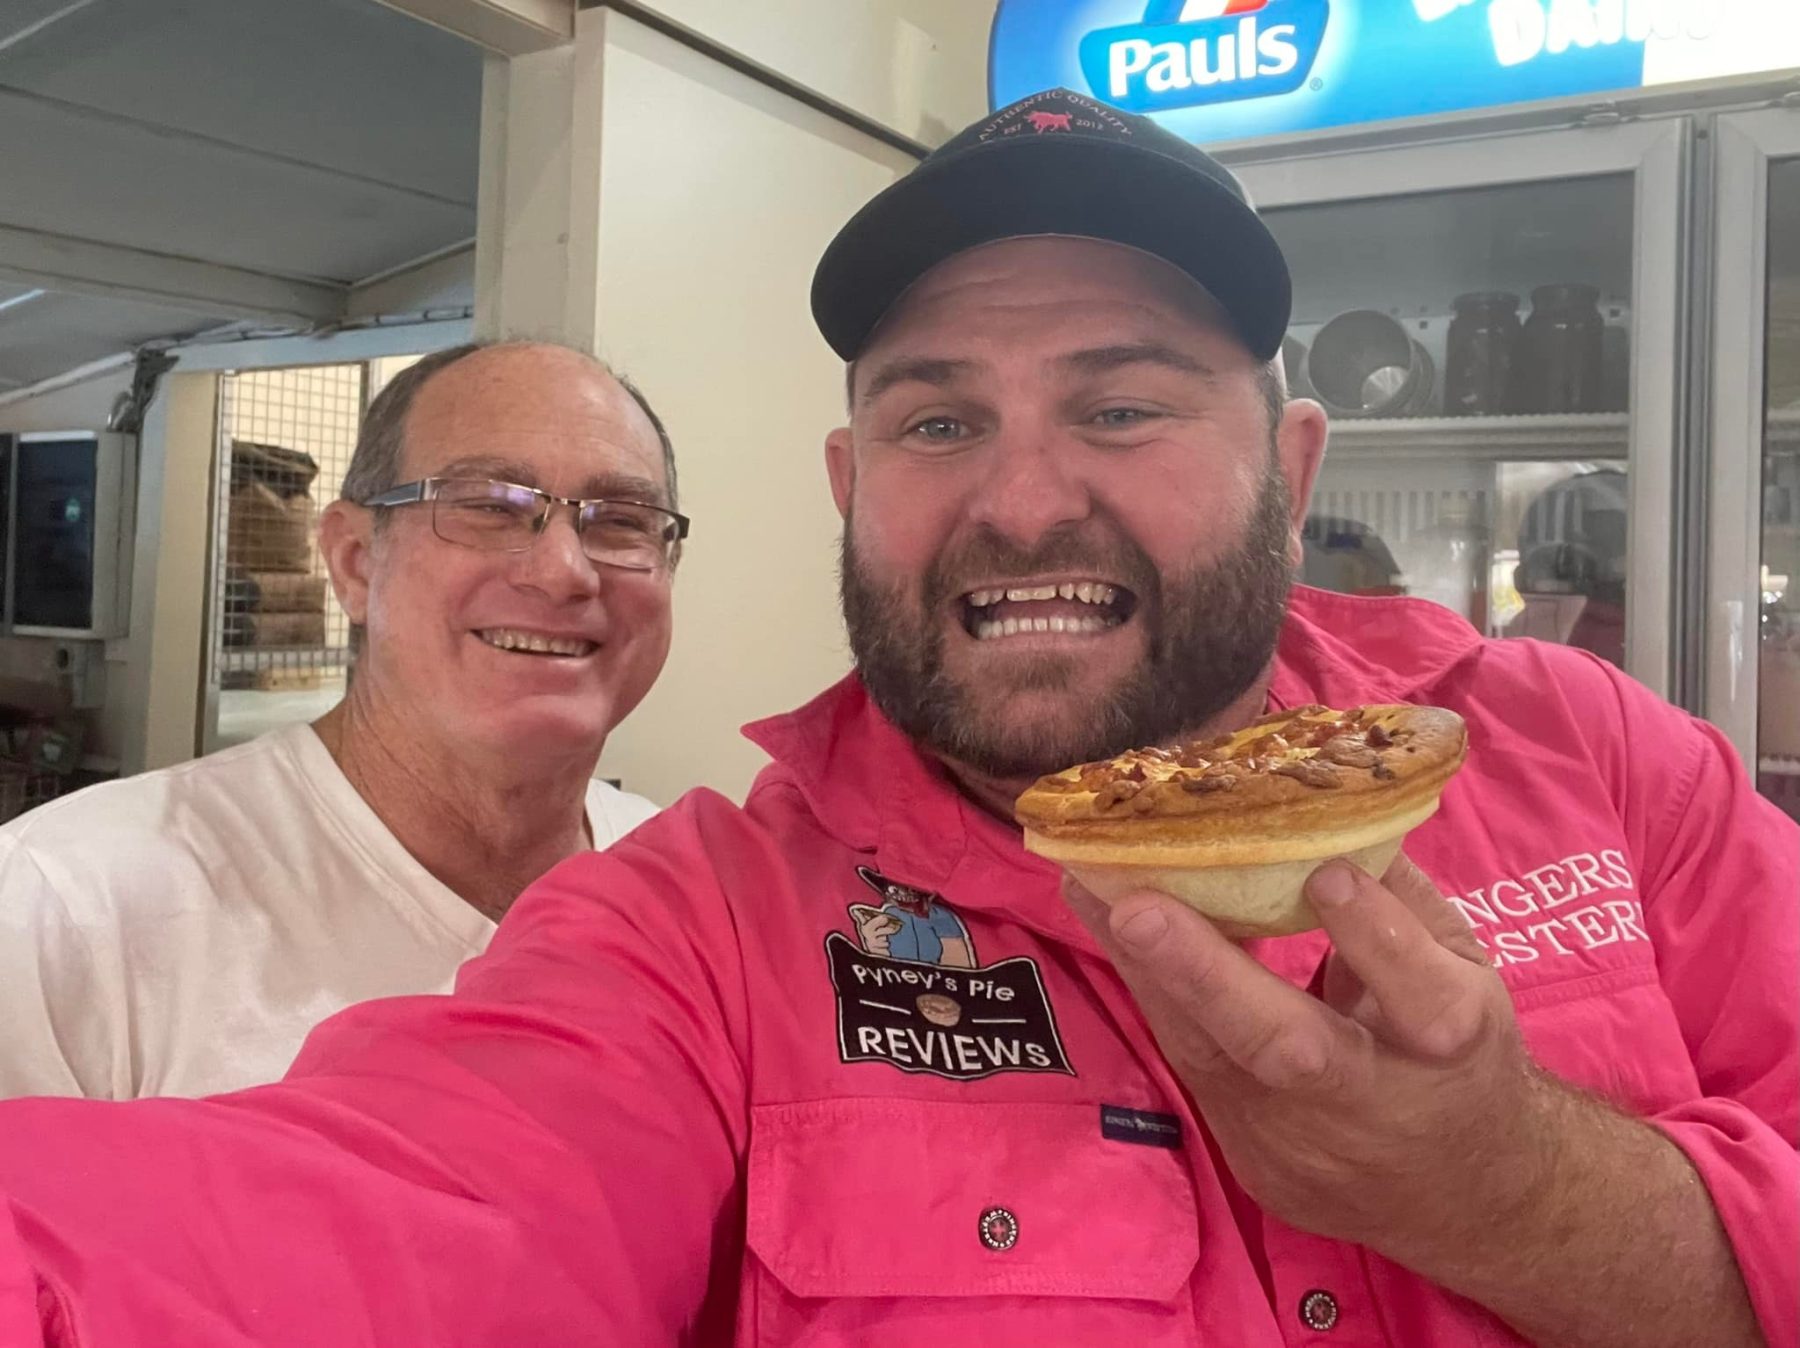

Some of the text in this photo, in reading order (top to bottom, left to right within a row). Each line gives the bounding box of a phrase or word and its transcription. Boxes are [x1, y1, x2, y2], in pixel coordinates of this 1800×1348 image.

[1108, 16, 1298, 98] Pauls
[978, 90, 1132, 144] AUTHENTIC QUALITY
[1446, 848, 1634, 929] NGERS
[1476, 900, 1650, 968] STER
[852, 963, 1016, 1002] Pyney's Pie
[857, 1026, 1052, 1071] REVIEWS
